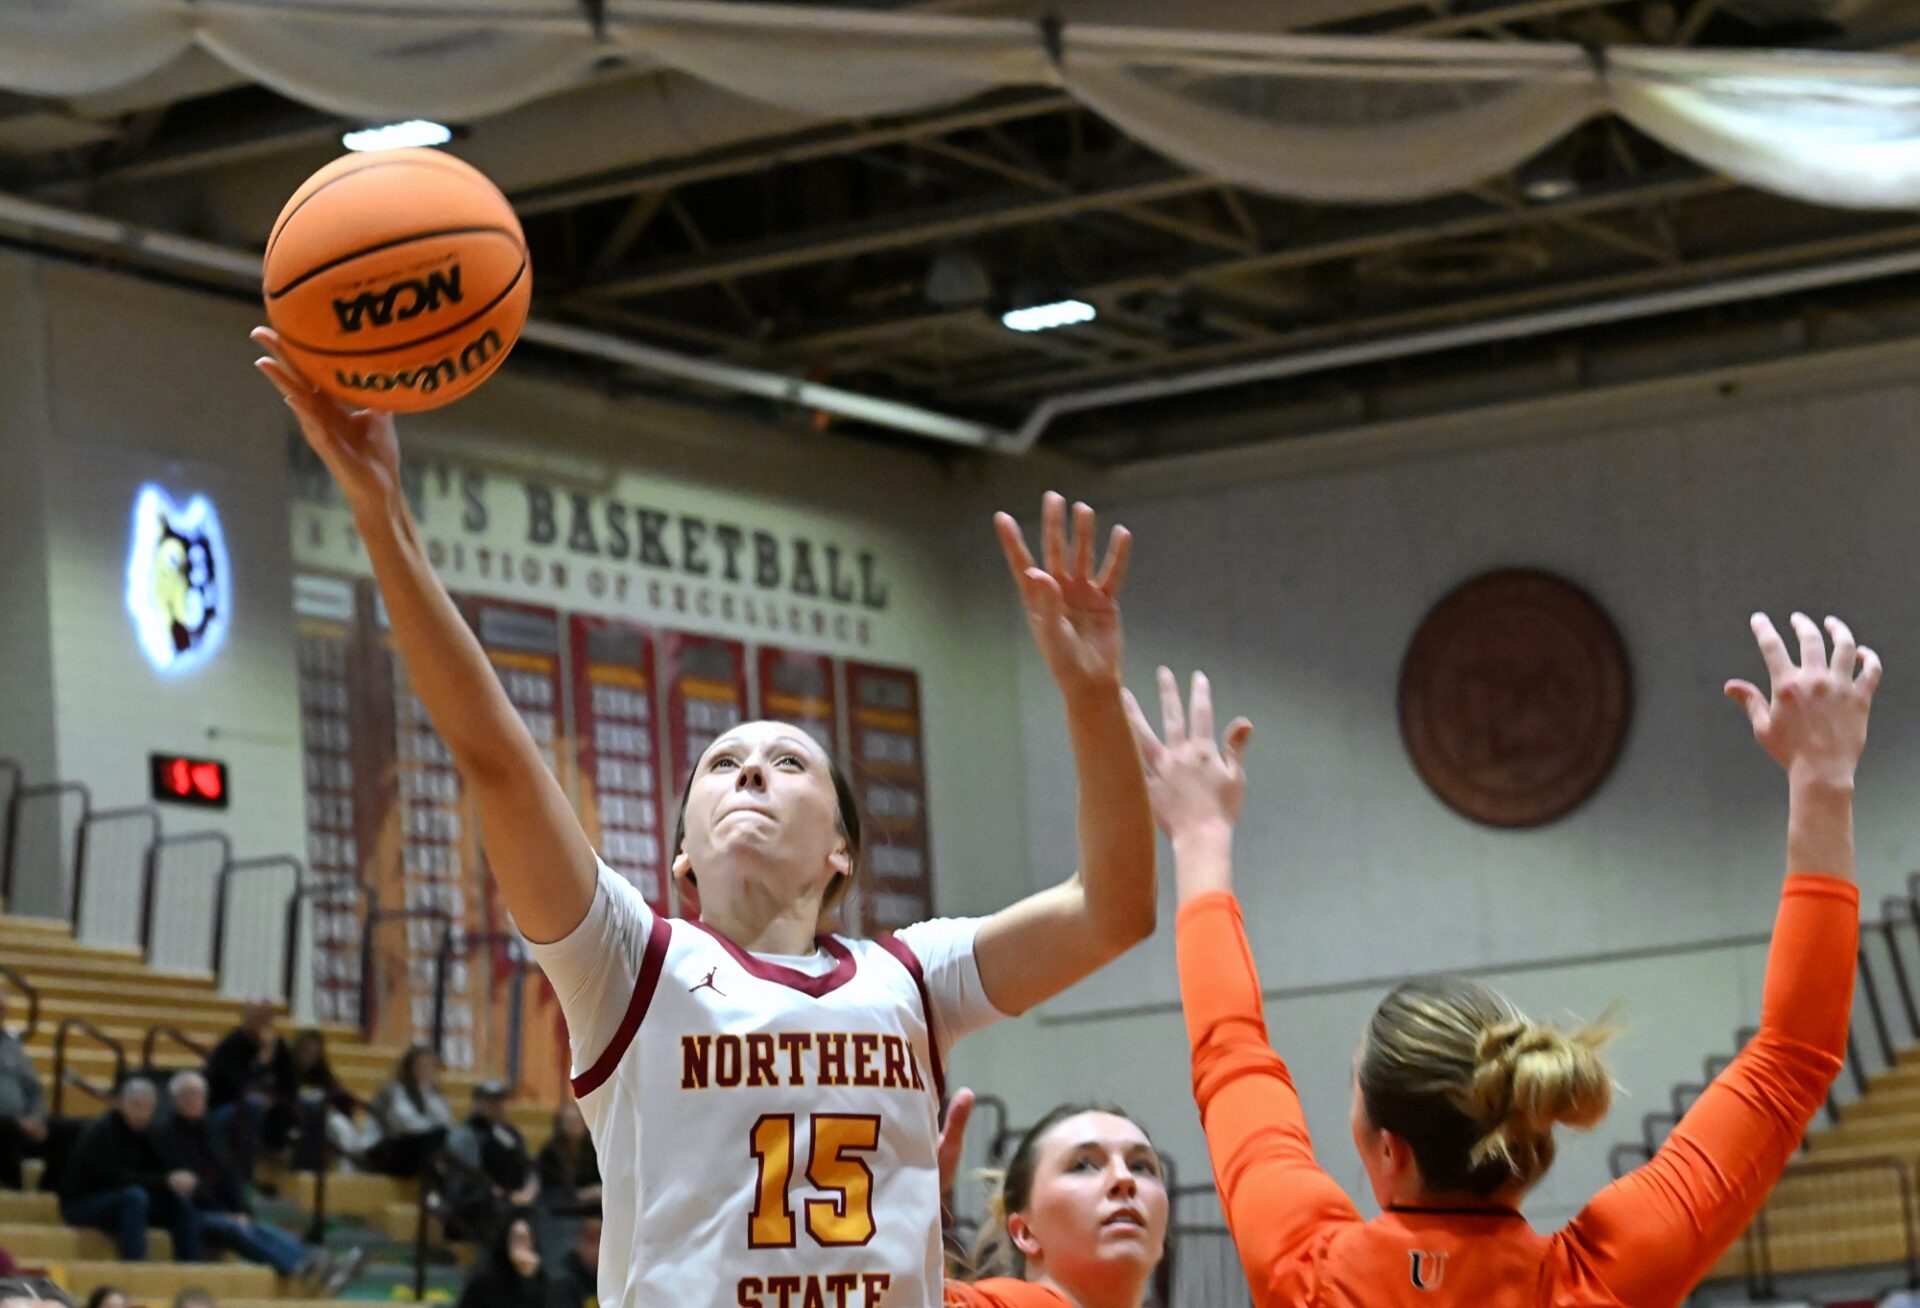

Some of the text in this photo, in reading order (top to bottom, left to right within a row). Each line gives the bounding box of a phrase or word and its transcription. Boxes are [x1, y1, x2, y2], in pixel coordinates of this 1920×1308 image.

[332, 263, 463, 333] NCAA
[335, 328, 503, 393] Wilson
[523, 483, 889, 611] BASKETBALL
[747, 1112, 882, 1250] 15
[1407, 1248, 1450, 1291] U
